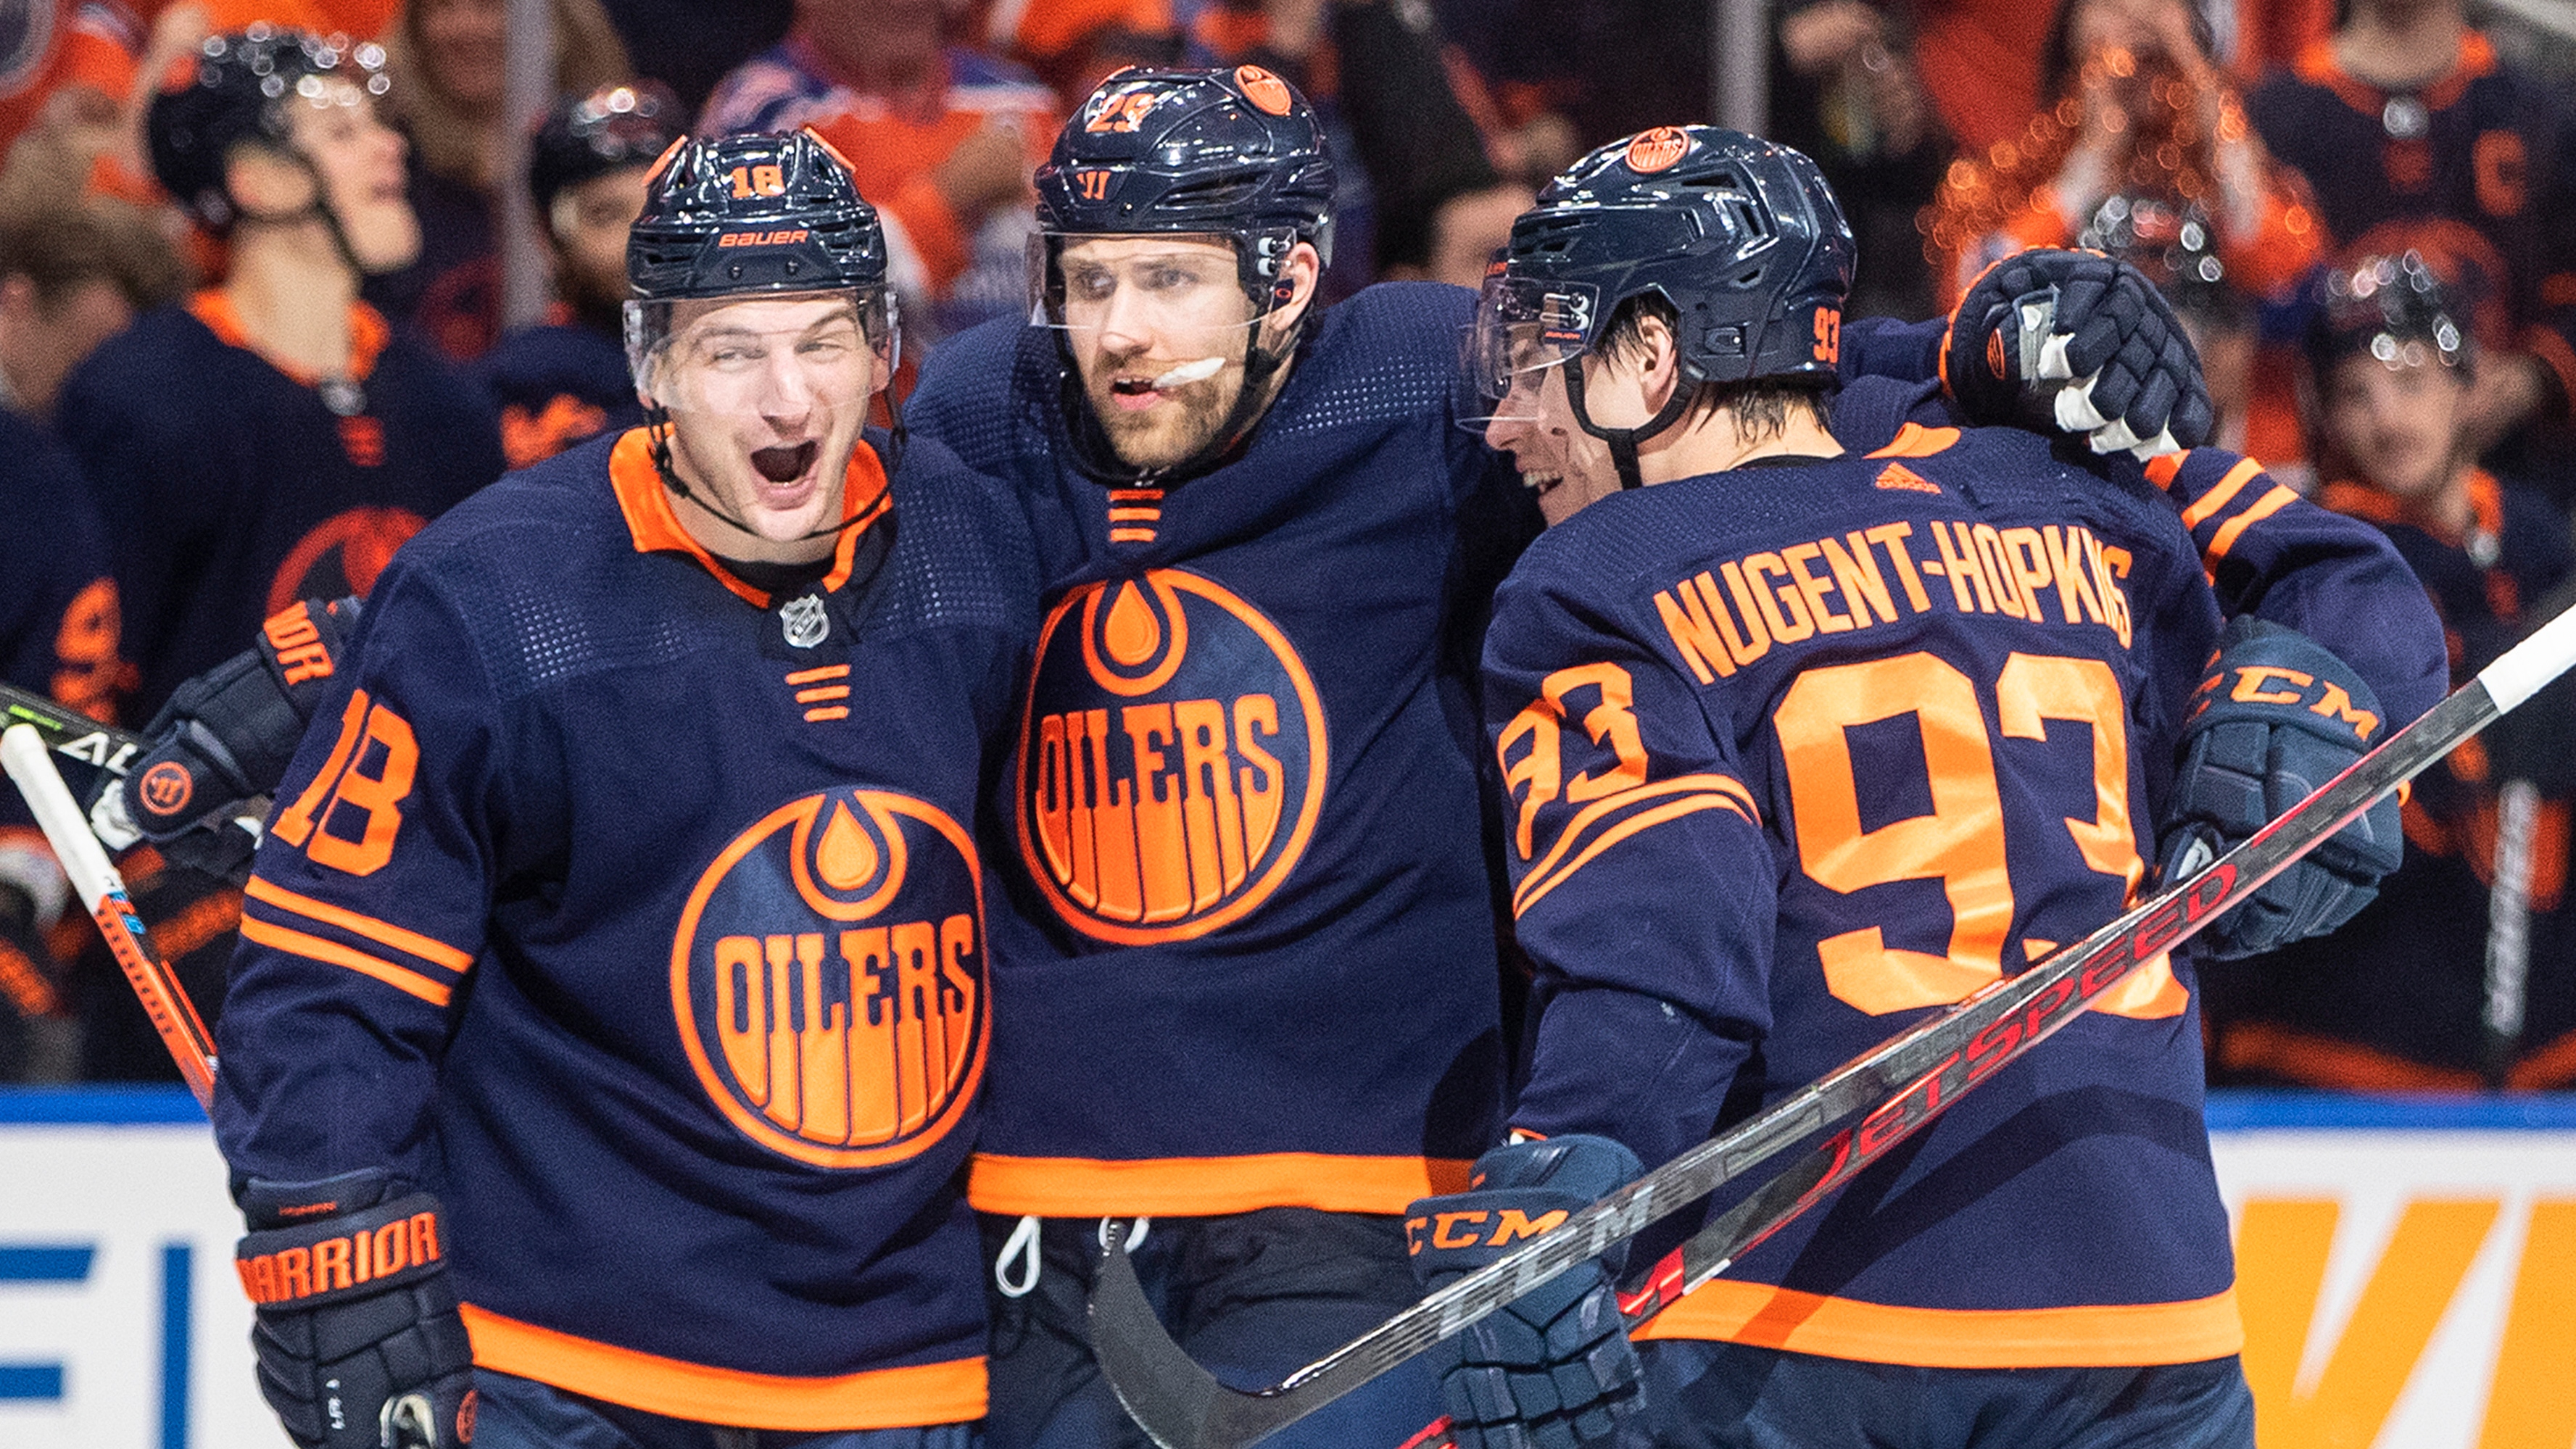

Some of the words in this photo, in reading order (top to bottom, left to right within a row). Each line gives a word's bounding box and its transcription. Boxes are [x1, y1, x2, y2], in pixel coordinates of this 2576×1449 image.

[718, 230, 808, 248] BAUER
[730, 165, 785, 198] 18
[1814, 307, 1839, 363] 93
[270, 689, 420, 876] 18
[1036, 694, 1284, 923] OILERS
[1497, 661, 1649, 860] 93
[1773, 650, 2190, 1020] 93
[716, 914, 975, 1147] OILERS
[1797, 863, 2238, 1205] JETSPEED
